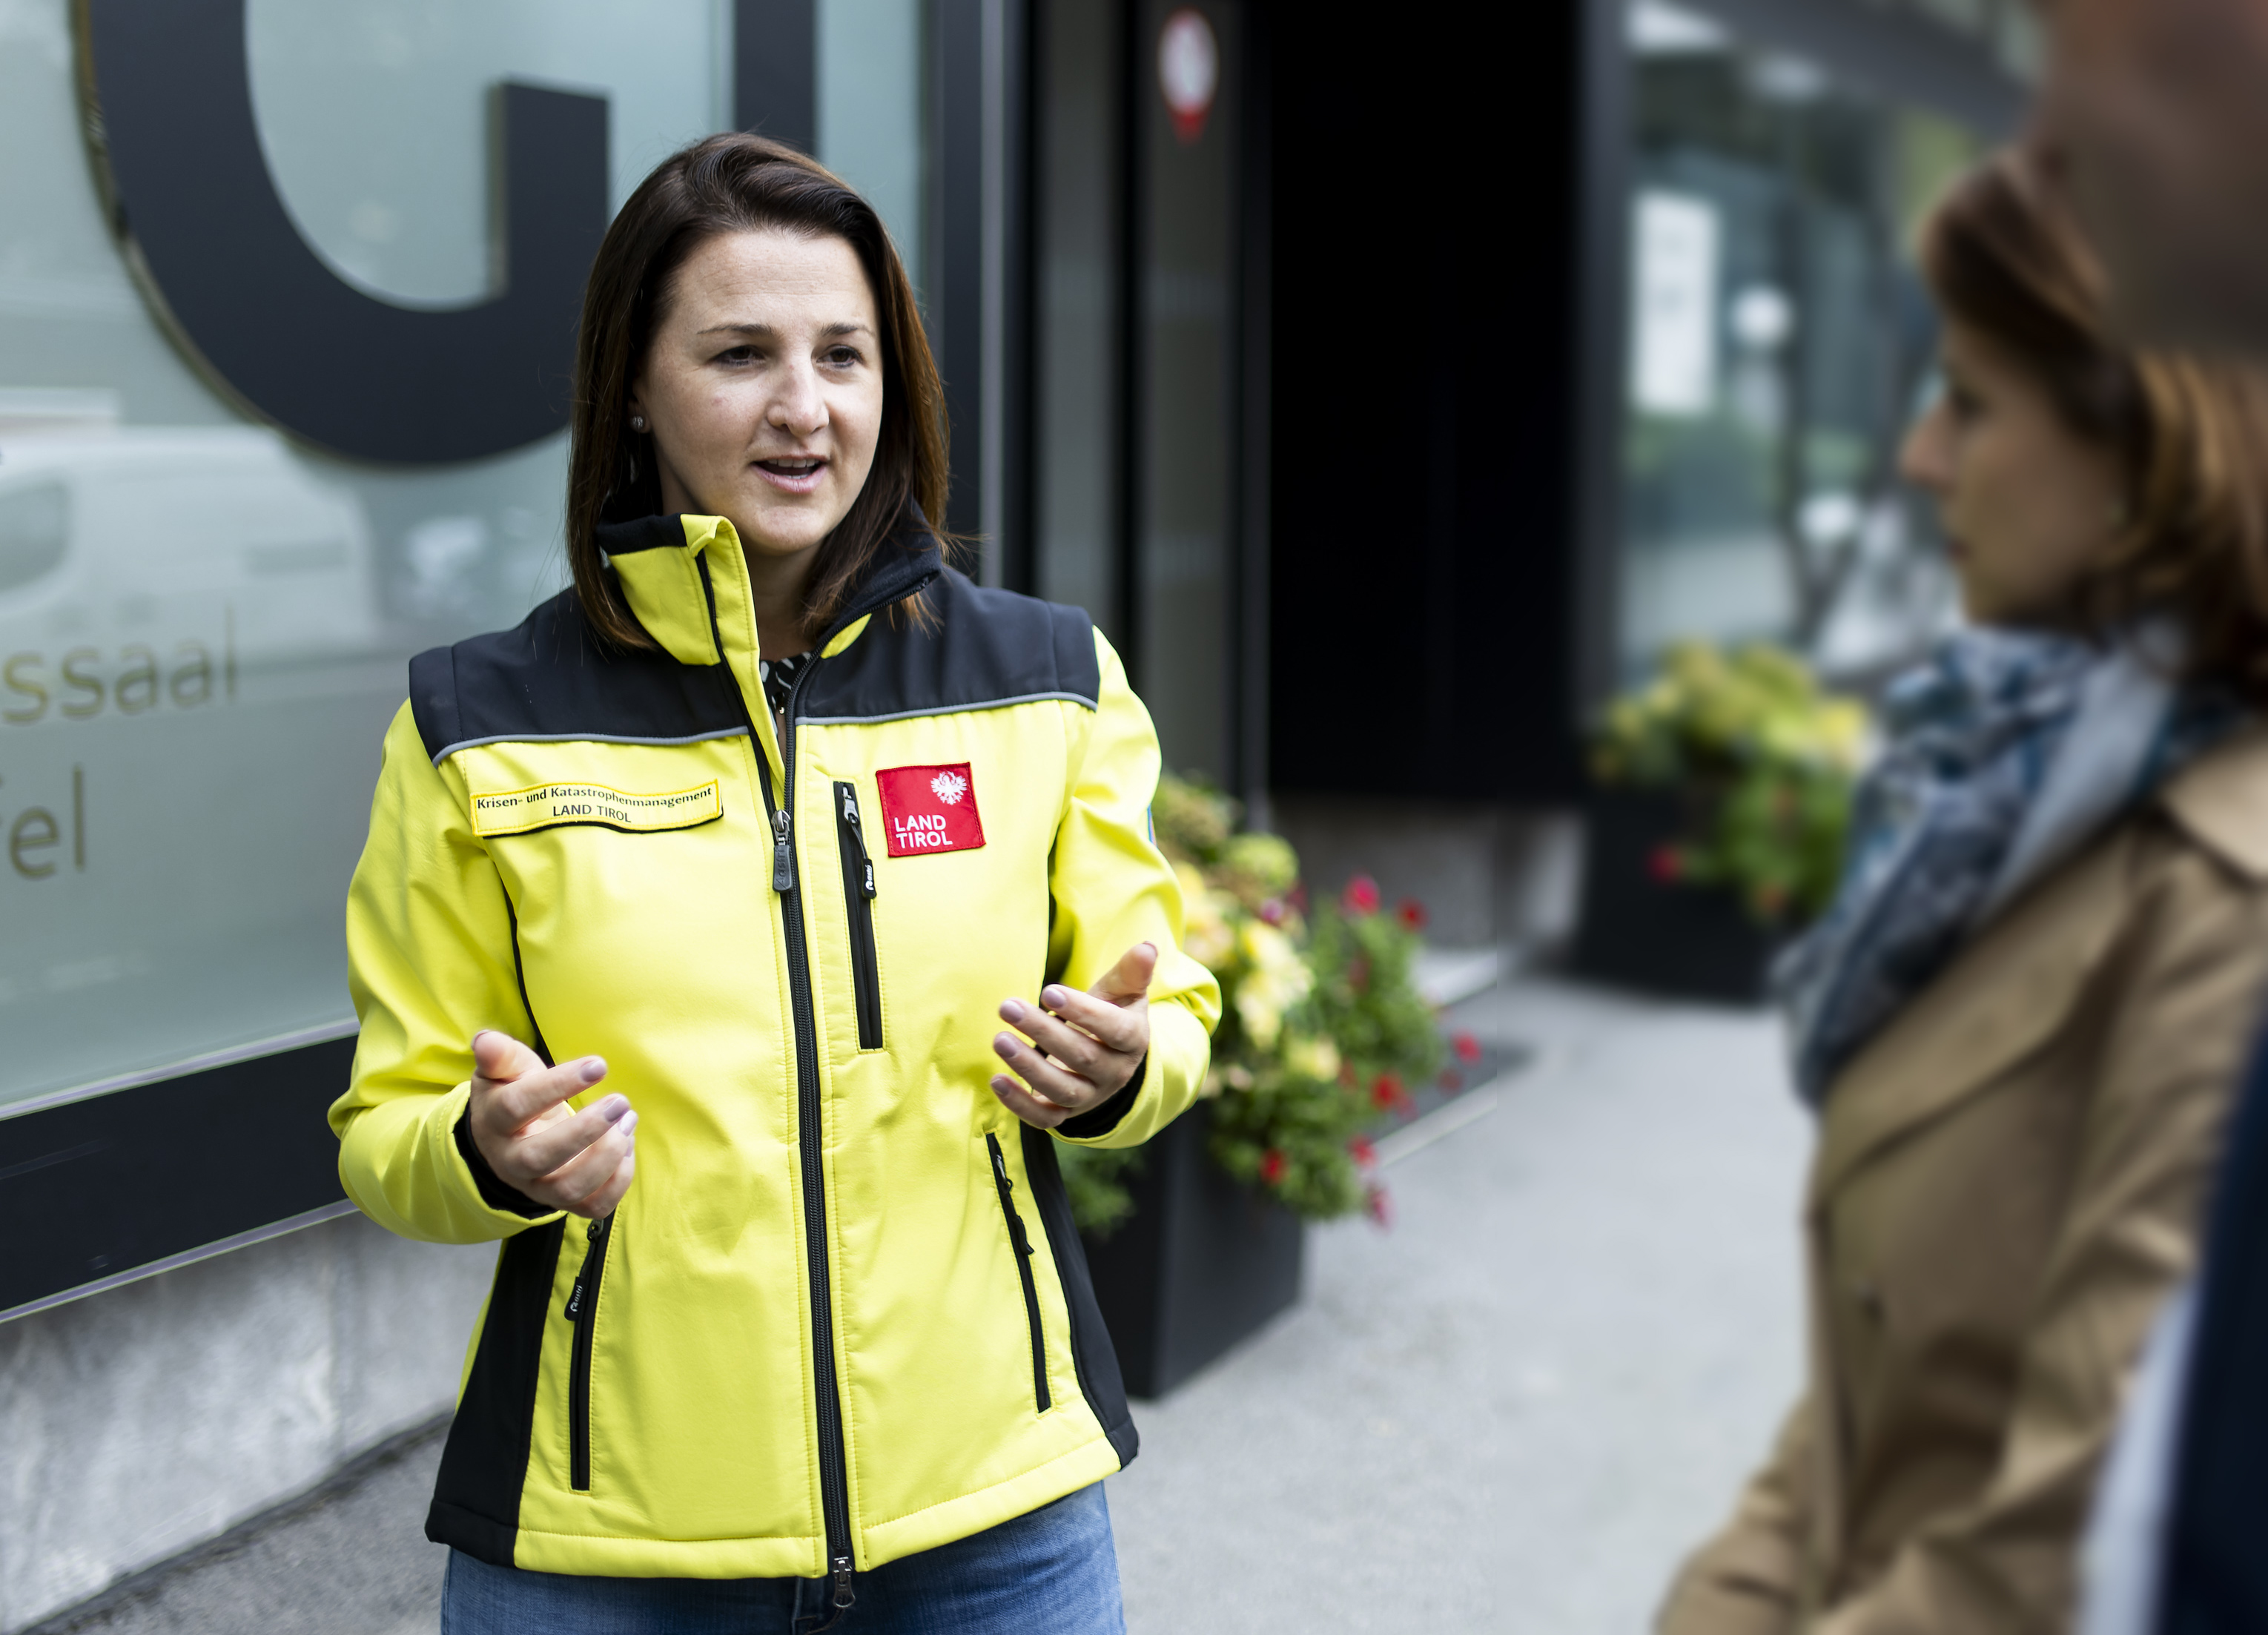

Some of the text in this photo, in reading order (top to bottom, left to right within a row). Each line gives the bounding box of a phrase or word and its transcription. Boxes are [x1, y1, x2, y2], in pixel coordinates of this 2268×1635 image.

[477, 787, 713, 810] Krisen- und Katastrophenmanagement
[0, 762, 87, 882] el
[552, 805, 632, 823] LAND TIROL
[893, 814, 947, 833] LAND
[895, 830, 953, 849] TIROL
